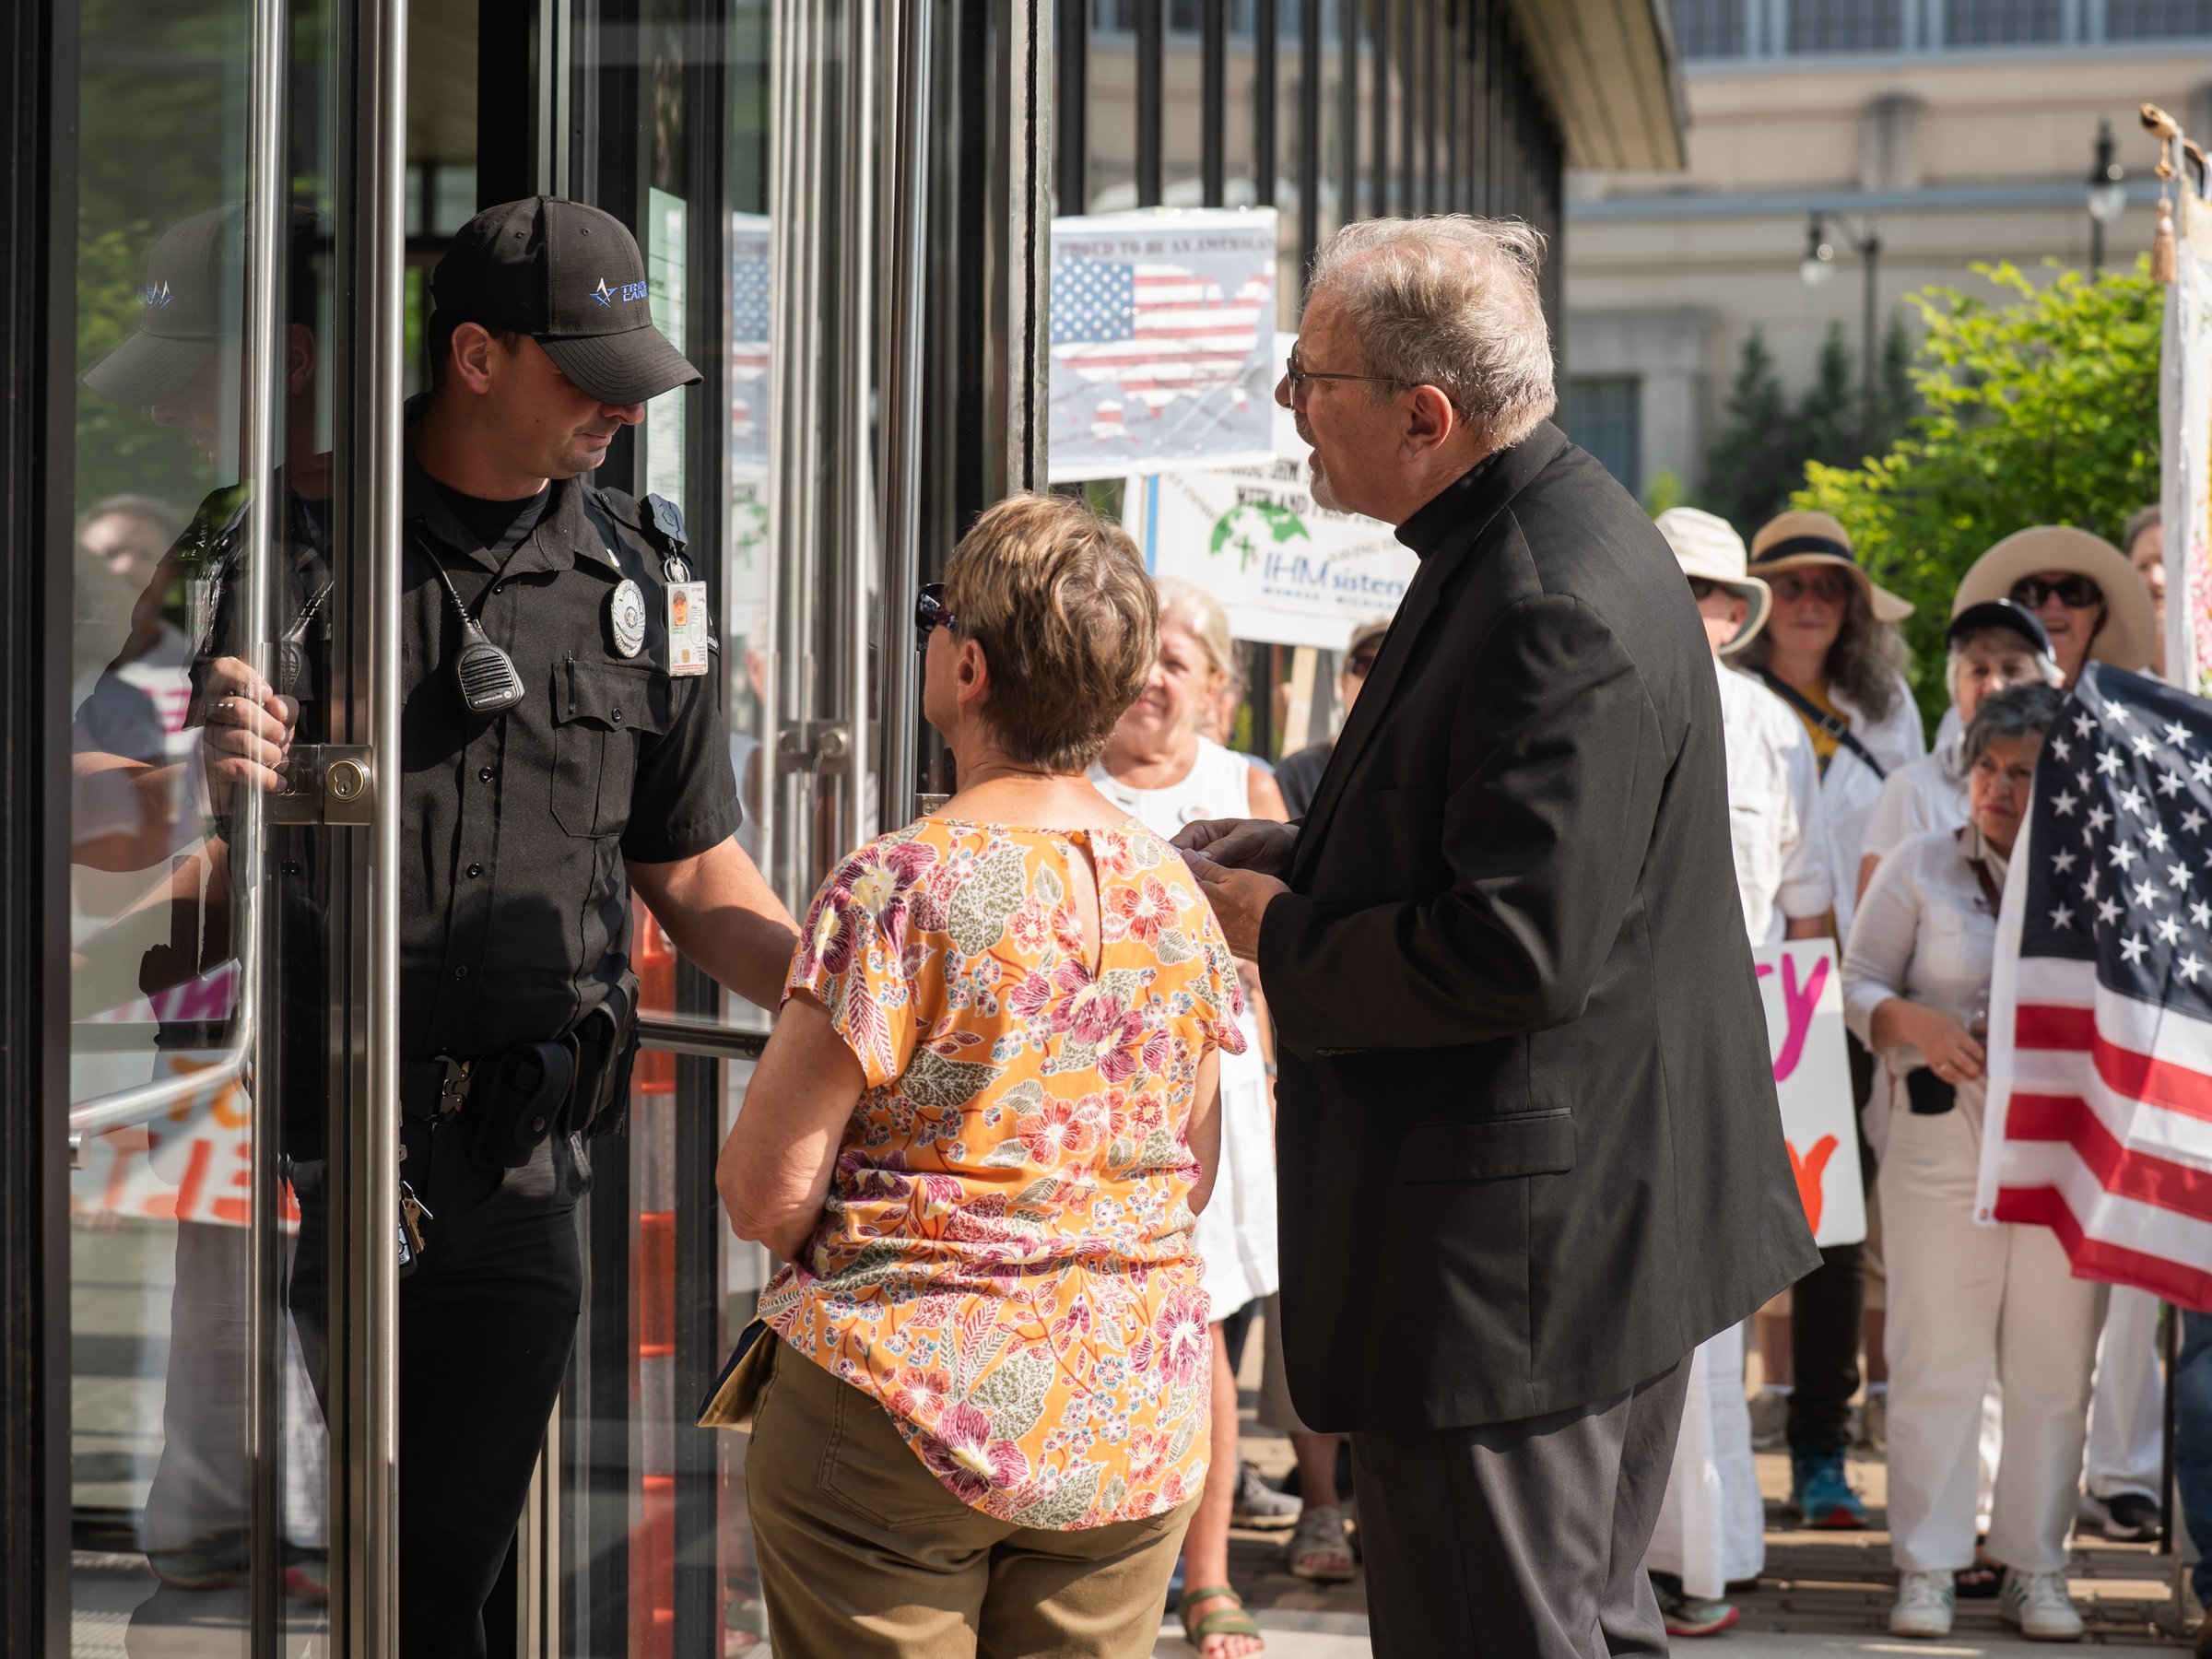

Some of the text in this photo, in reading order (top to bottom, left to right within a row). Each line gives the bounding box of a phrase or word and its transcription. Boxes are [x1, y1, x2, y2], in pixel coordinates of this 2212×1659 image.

[1119, 240, 1141, 254] TO
[1145, 240, 1165, 253] BE
[1264, 552, 1330, 588] IHM
